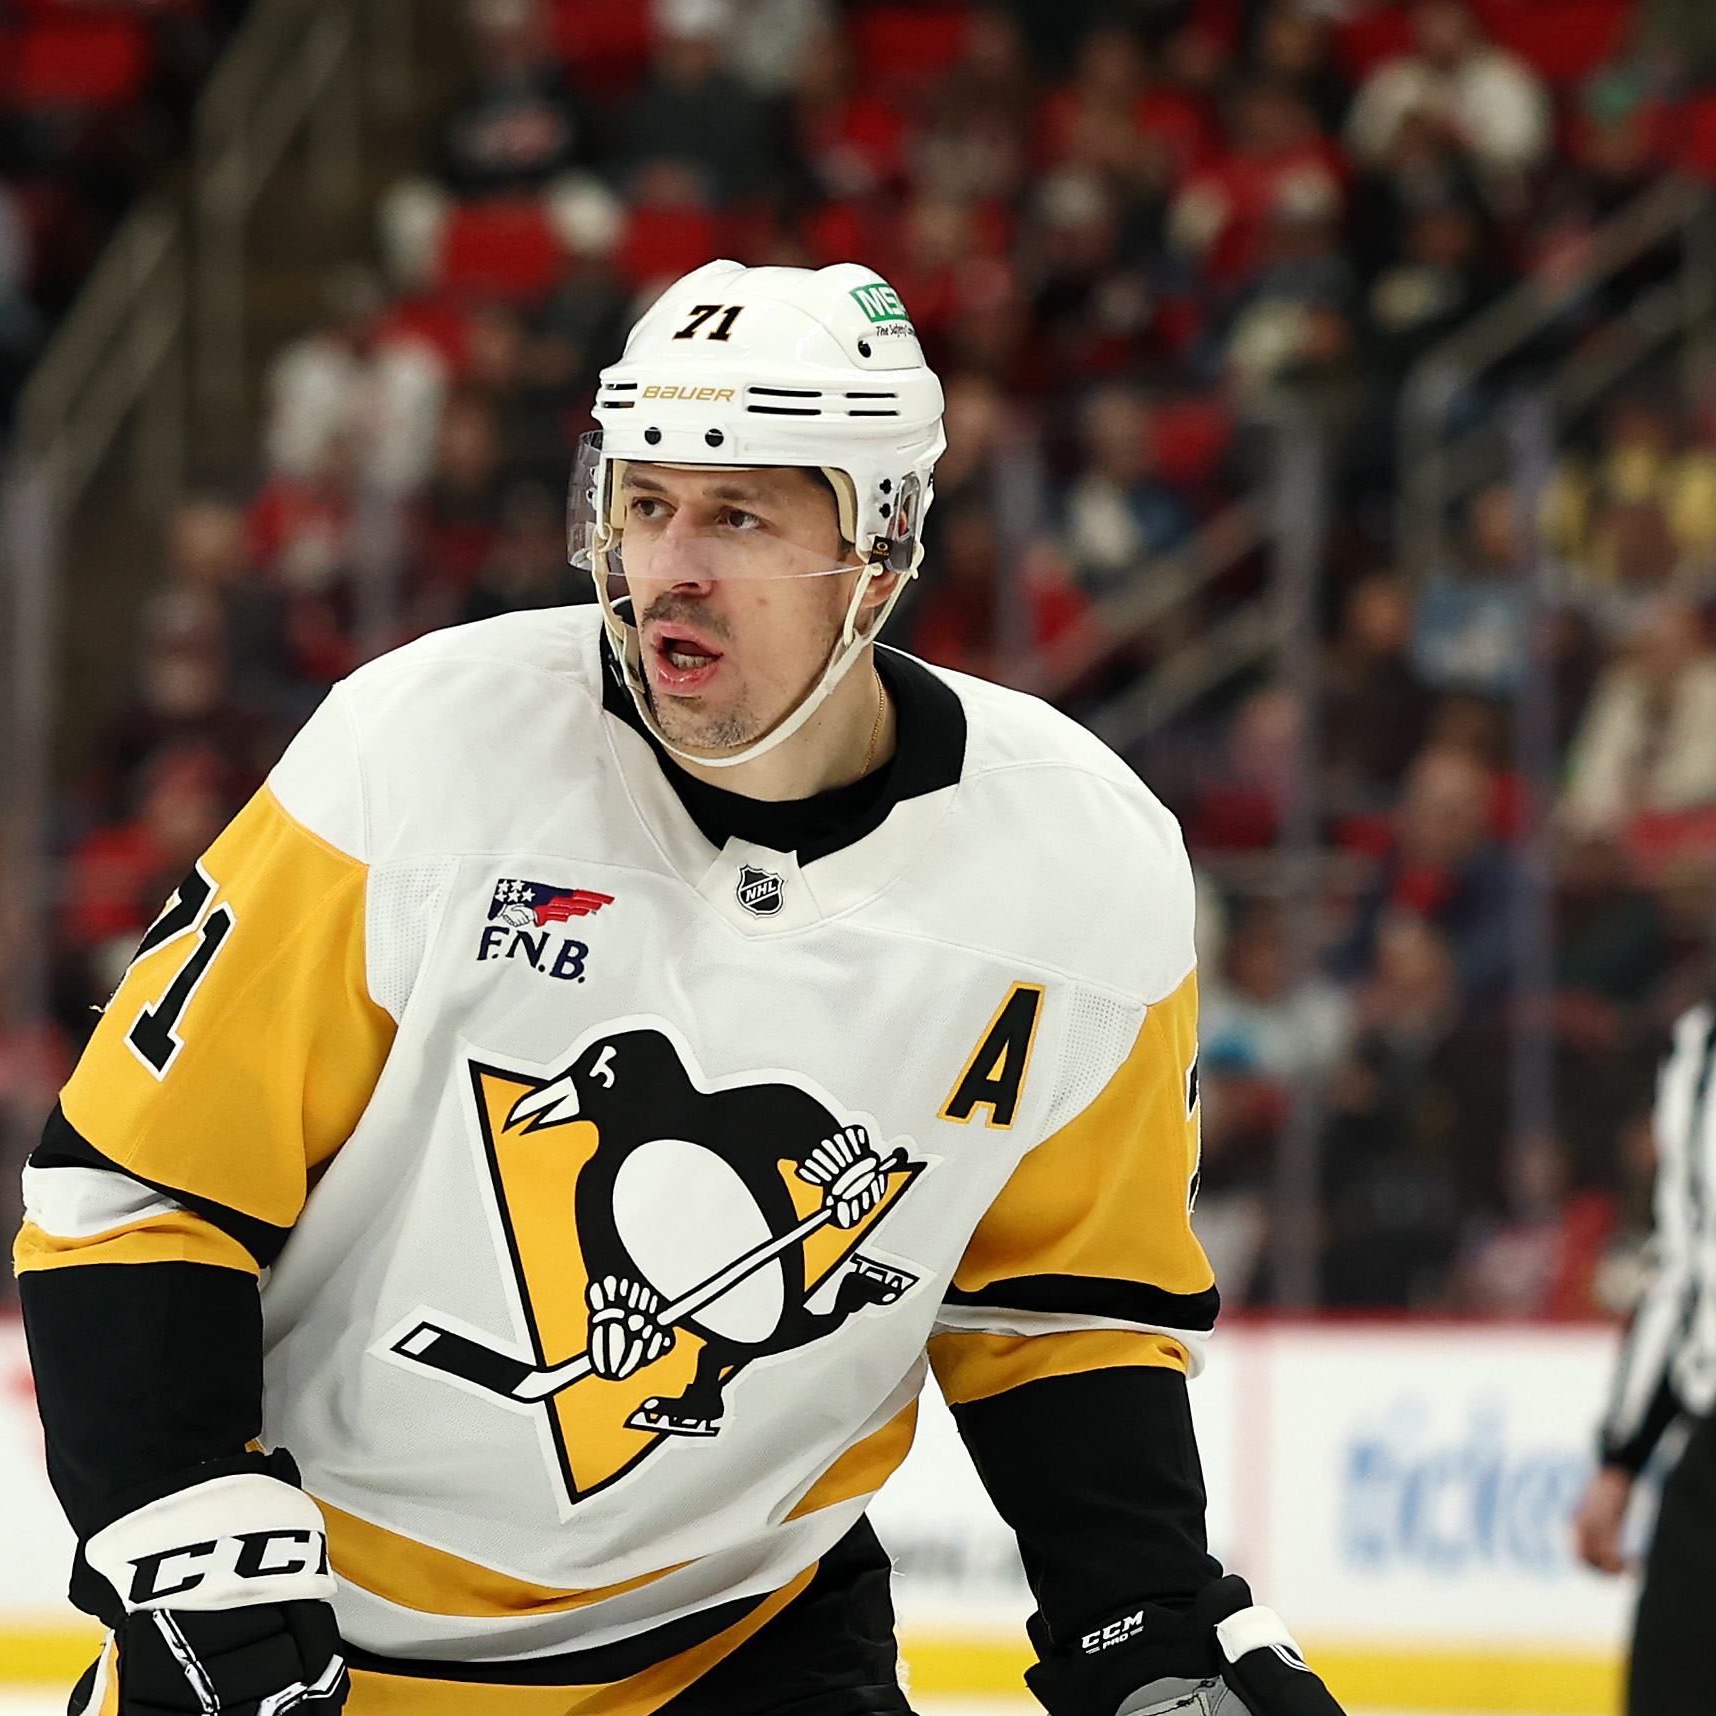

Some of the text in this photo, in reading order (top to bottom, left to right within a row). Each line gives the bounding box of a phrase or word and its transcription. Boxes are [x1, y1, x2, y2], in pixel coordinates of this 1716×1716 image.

[672, 304, 745, 342] 71
[746, 880, 777, 902] NHL
[476, 925, 590, 984] F.N.B.
[936, 980, 1047, 1130] A
[125, 1529, 329, 1605] CC
[1081, 1610, 1144, 1649] CCM
[1102, 1633, 1129, 1650] PRO
